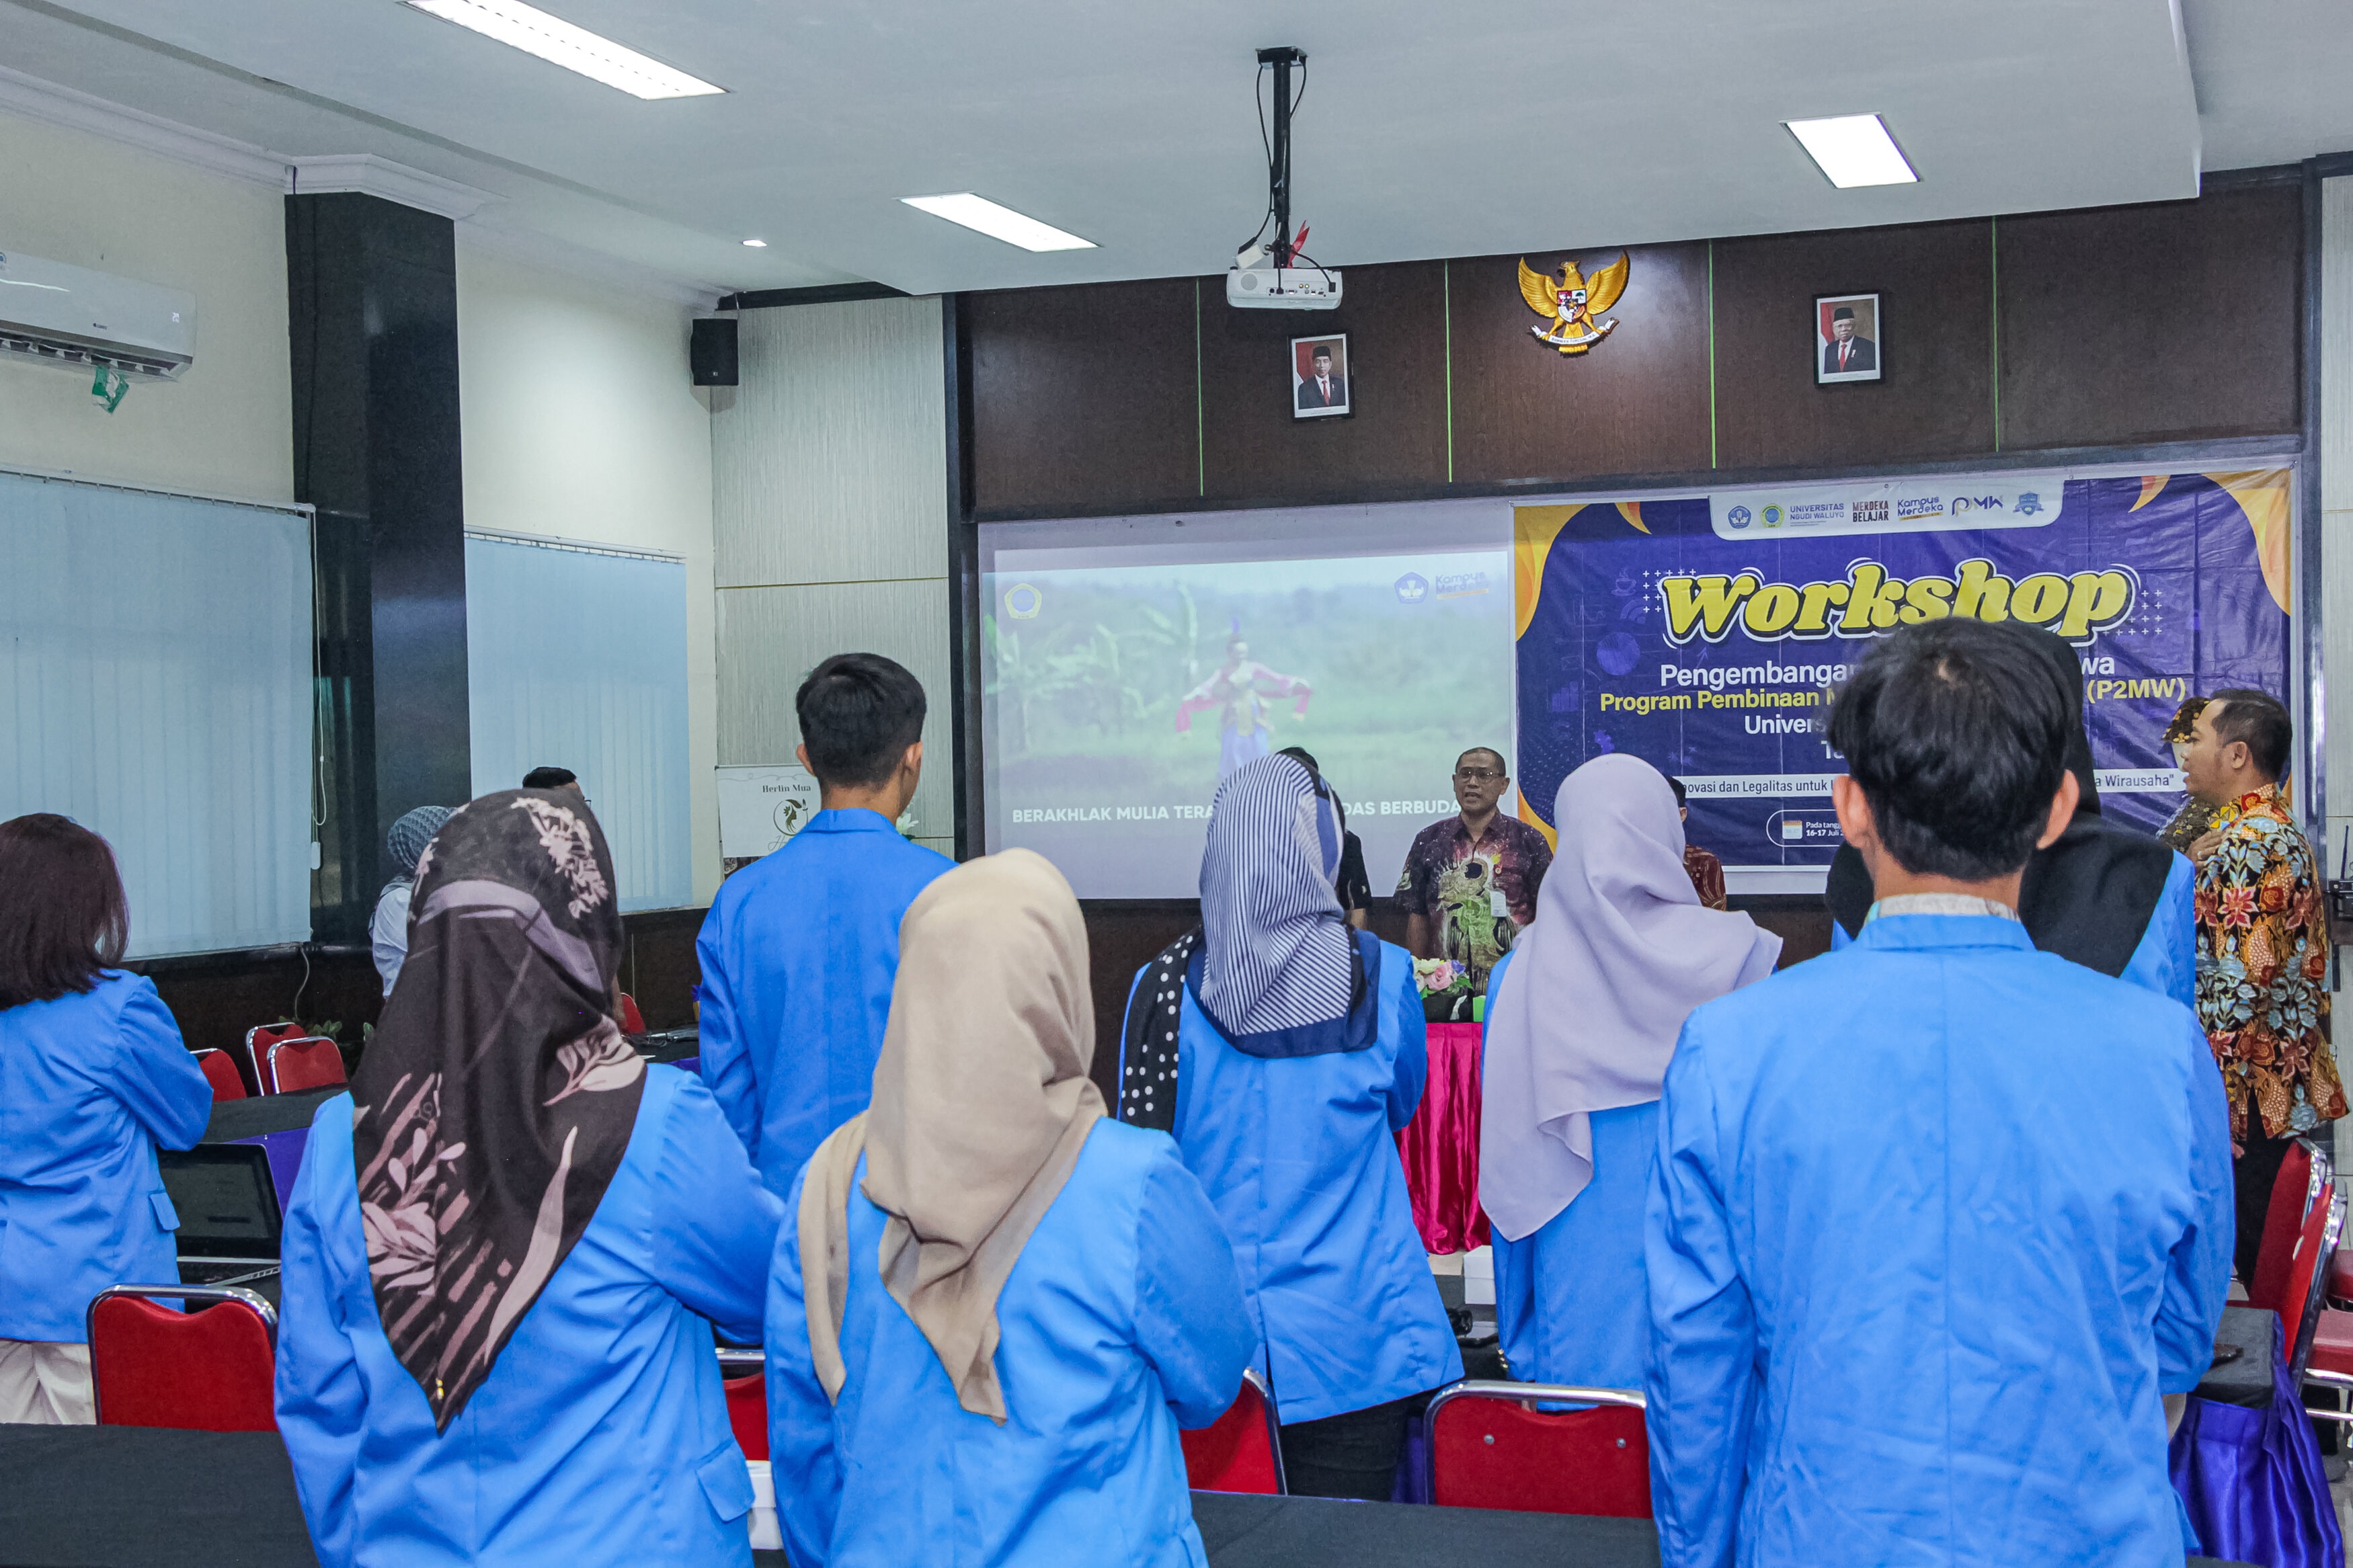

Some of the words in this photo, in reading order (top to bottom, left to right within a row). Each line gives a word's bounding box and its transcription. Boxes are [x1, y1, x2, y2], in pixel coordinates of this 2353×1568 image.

[1790, 503, 1844, 513] UNIVERSITAS
[1853, 501, 1888, 511] MERDEKA
[1897, 496, 1939, 508] Kampus
[1897, 503, 1943, 516] Merdeka
[1853, 511, 1888, 522] BELAJAR
[1435, 572, 1486, 585] Kampus
[1659, 557, 2132, 640] Workshop
[1601, 693, 1691, 715] Program
[1698, 688, 1819, 708] Pembinaan
[2087, 677, 2186, 704] (P2MW)
[1719, 780, 1739, 792] dan
[1743, 780, 1792, 794] Legalitas
[1796, 779, 1828, 791] untuk
[1012, 808, 1111, 823] BERAKHLAK
[1116, 807, 1169, 820] MULIA
